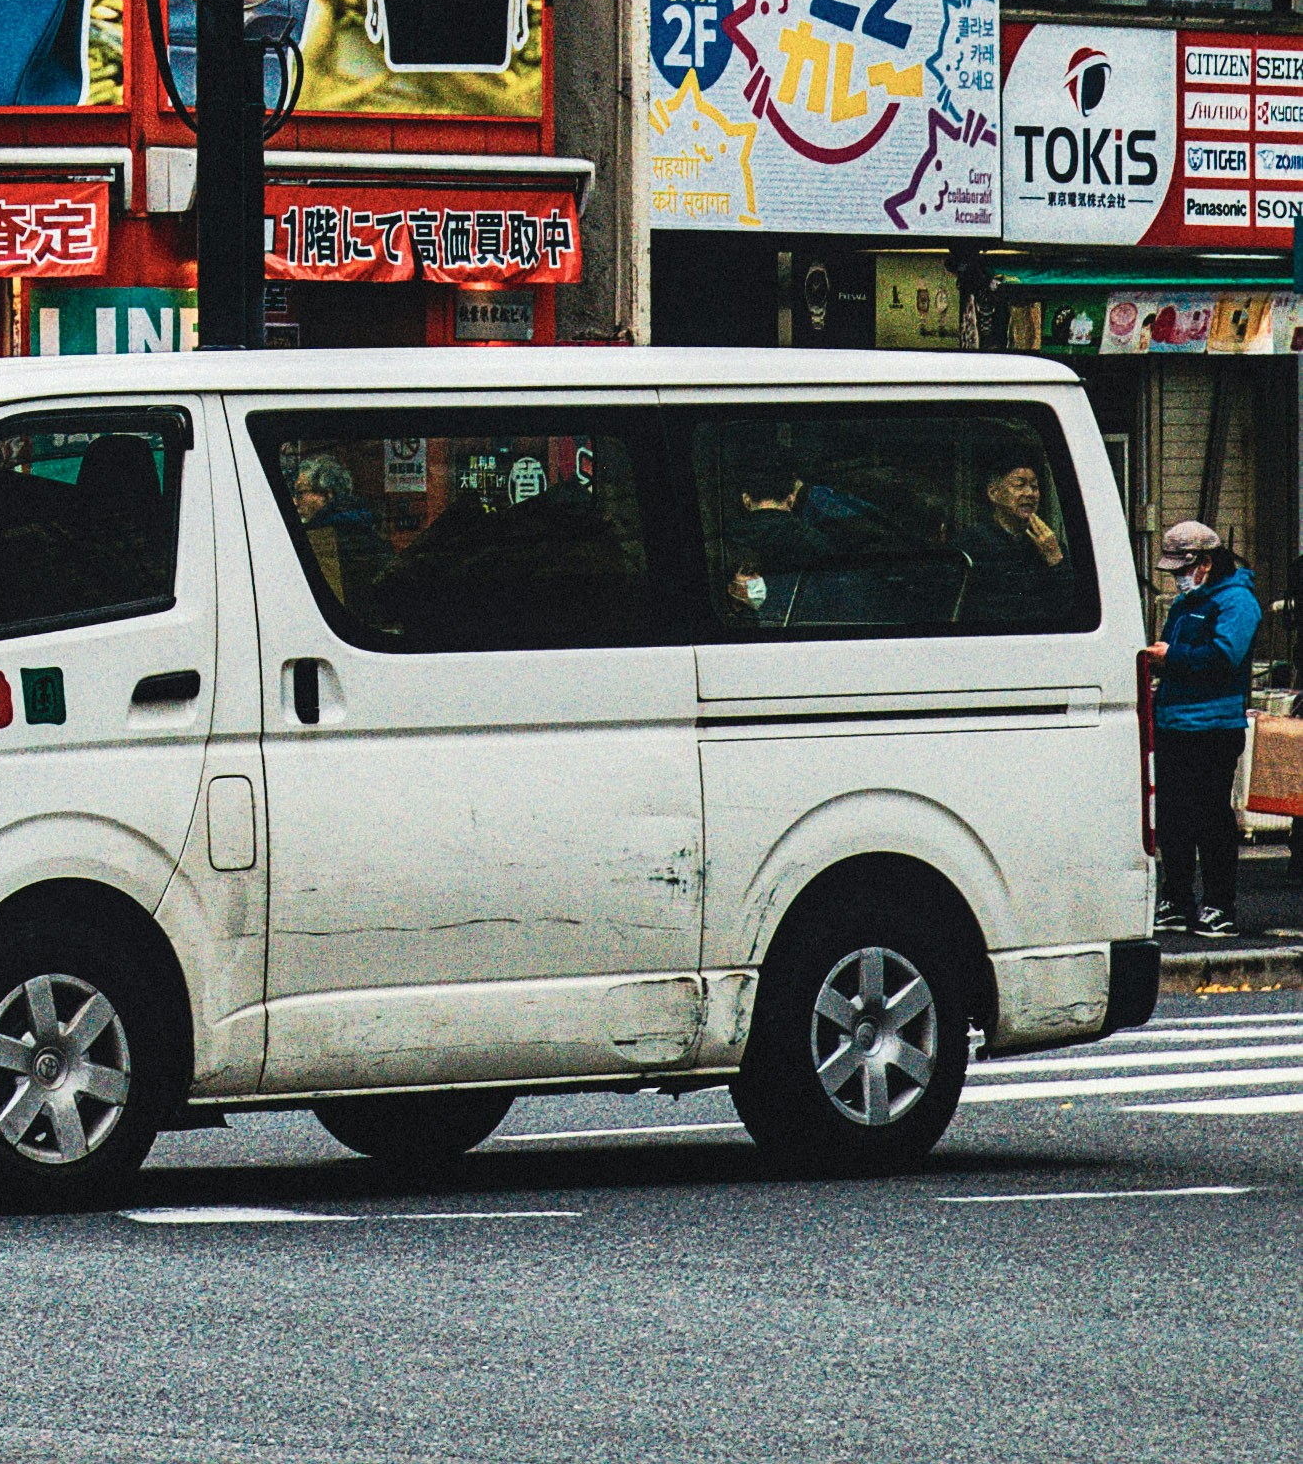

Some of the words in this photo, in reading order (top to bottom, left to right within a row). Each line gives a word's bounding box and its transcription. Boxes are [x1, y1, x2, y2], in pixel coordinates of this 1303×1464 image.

[662, 5, 718, 68] 2F
[776, 19, 924, 123] カレー
[1185, 52, 1250, 77] CITIZEN
[1187, 101, 1248, 120] SHISEIDO
[1203, 149, 1247, 171] TIGER
[1186, 198, 1247, 217] Panasonic
